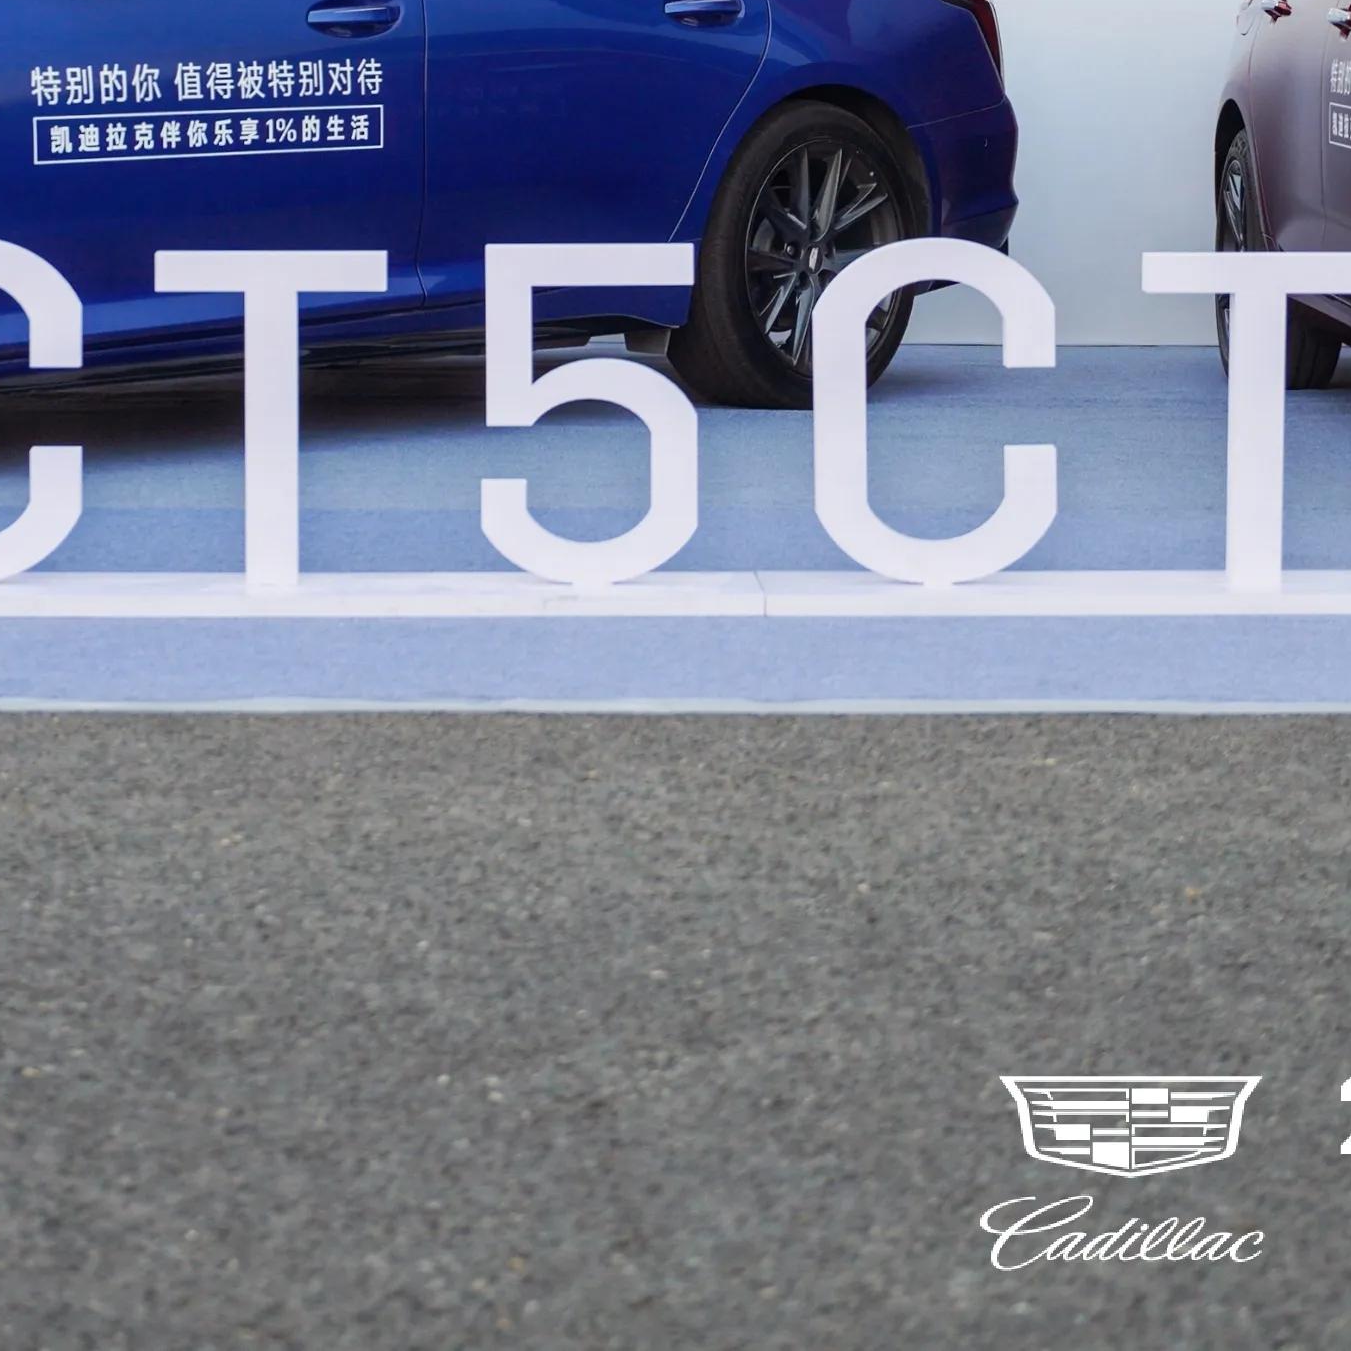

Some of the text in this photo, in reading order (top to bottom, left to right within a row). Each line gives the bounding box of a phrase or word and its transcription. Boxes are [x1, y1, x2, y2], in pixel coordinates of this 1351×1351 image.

[31, 58, 383, 106] 特别的你 值得被特别对待
[50, 114, 370, 154] 凯迪拉克伴你乐享1%的生活
